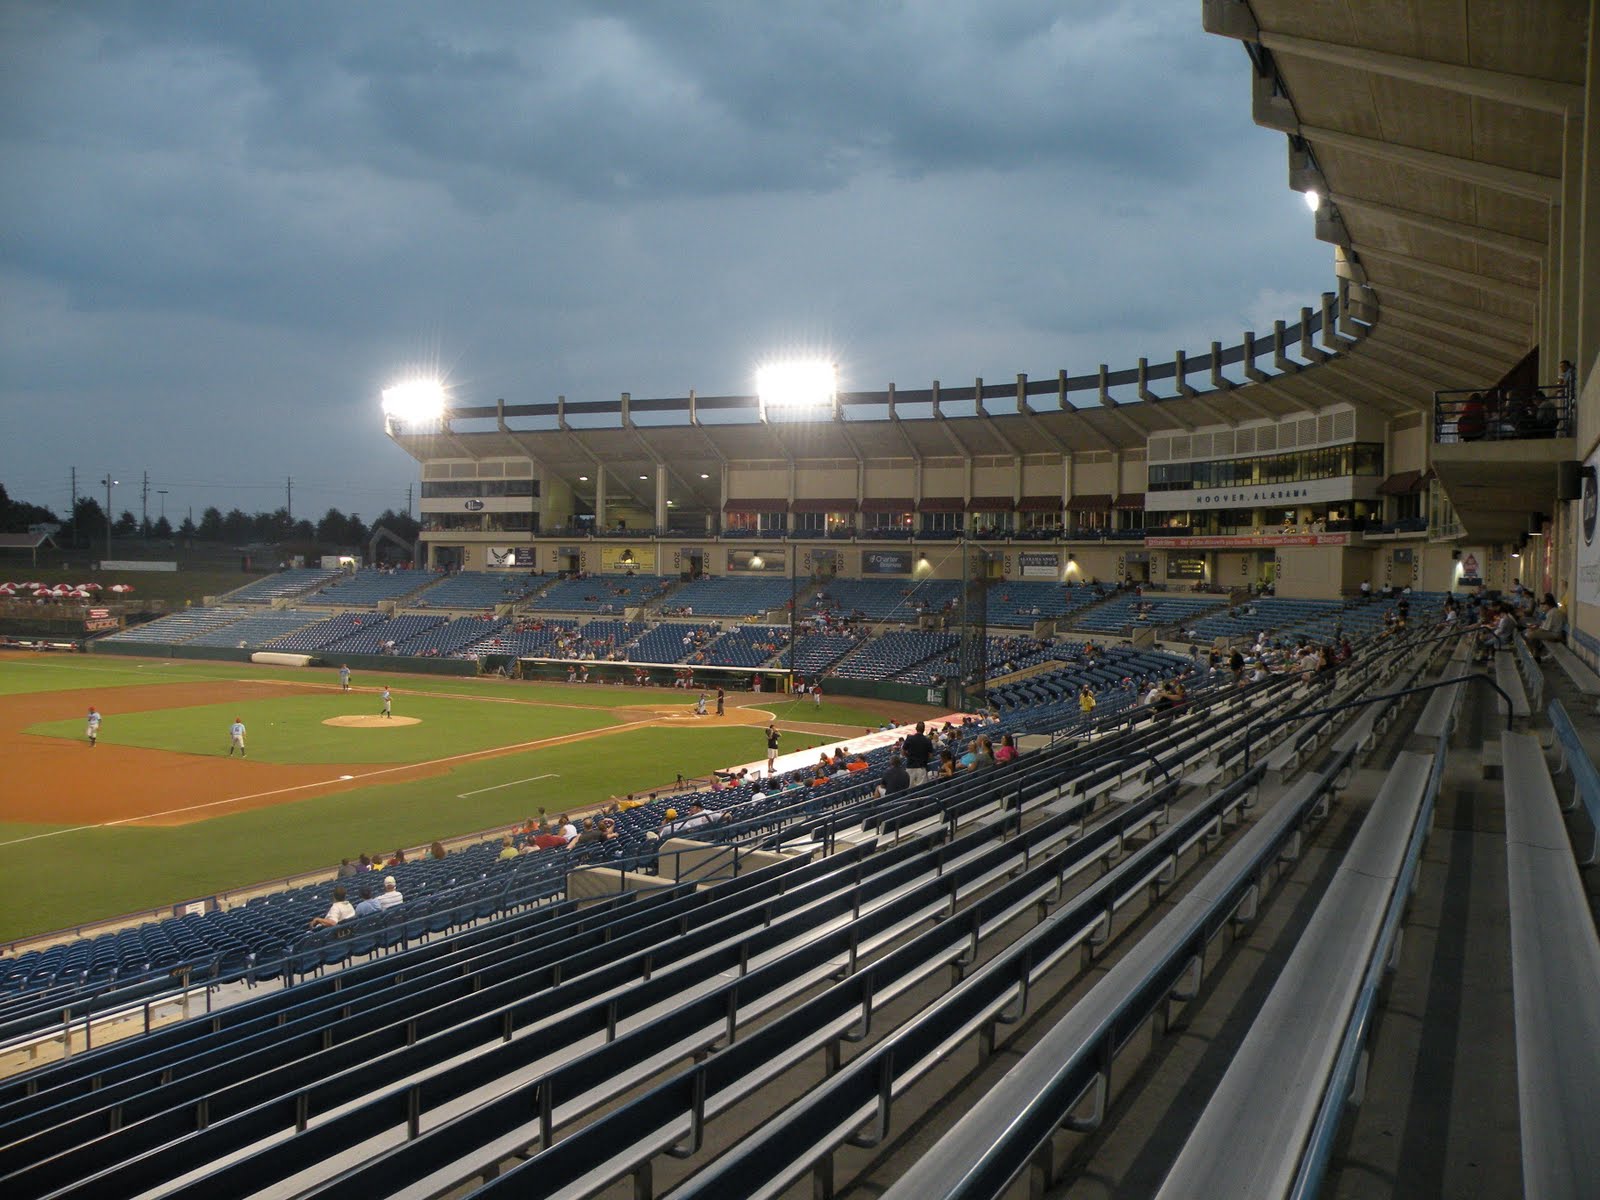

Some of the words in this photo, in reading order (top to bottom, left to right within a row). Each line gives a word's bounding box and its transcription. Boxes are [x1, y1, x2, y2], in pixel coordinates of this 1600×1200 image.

[1197, 494, 1250, 503] HOOVER,
[1254, 489, 1307, 499] ALABAMA
[1004, 555, 1012, 574] 203
